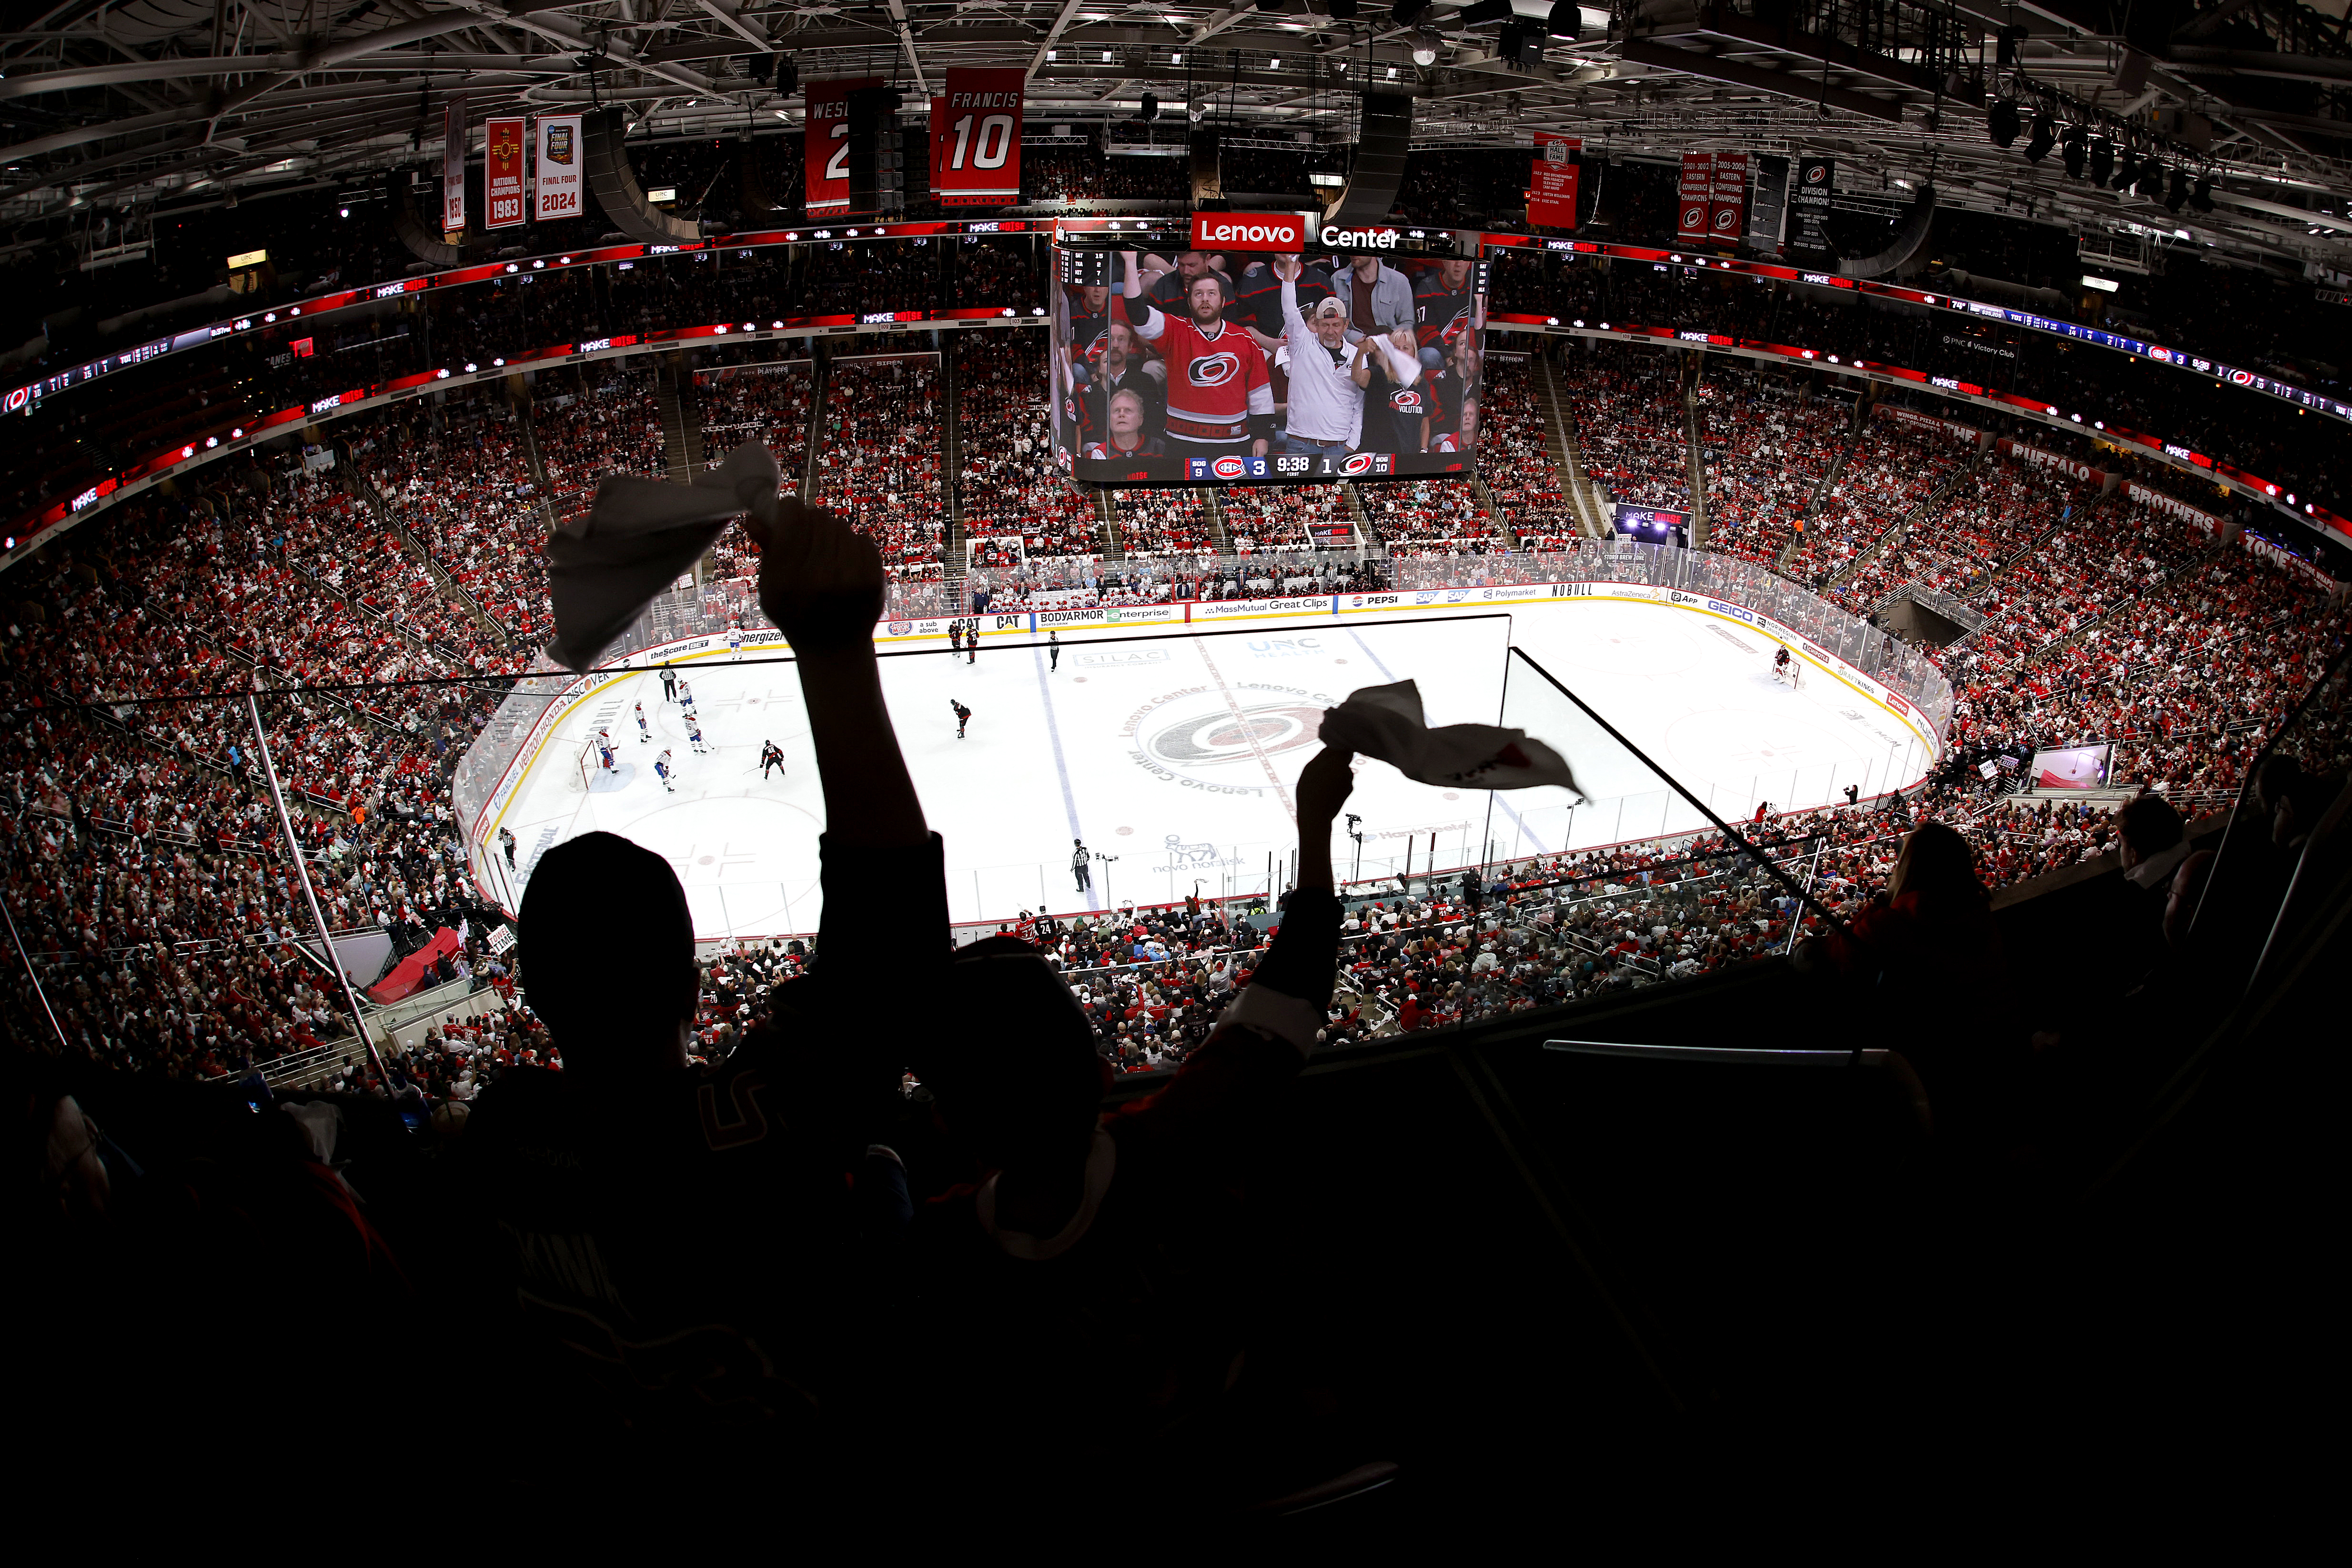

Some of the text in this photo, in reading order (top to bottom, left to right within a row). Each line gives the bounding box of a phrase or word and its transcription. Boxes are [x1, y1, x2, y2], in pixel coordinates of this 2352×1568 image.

[951, 92, 1018, 108] FRANCIS
[550, 141, 568, 150] FOUR
[951, 114, 1014, 170] 10
[1717, 161, 1745, 170] 2005-2006
[493, 176, 518, 187] NATIONAL
[542, 174, 577, 186] FINAL FOUR
[1720, 172, 1740, 181] EASTERN
[491, 185, 520, 197] CHAMPIONS
[1716, 183, 1742, 192] CONFERENCE
[1802, 187, 1827, 196] DIVISION
[542, 191, 576, 211] 2024
[1715, 193, 1741, 204] CHAMPIONS
[449, 197, 461, 219] 1950
[493, 199, 518, 219] 1983
[969, 221, 1026, 233] MAKE NOISE
[1201, 220, 1401, 249] Lenovo Center
[1548, 241, 1598, 252] MAKE NOISE
[377, 278, 428, 299] MAKE NOISE
[863, 310, 923, 324] MAKE NOISE
[1416, 306, 1425, 323] 37
[2010, 313, 2022, 322] TOI
[1951, 338, 2014, 358] PNC Victory Club
[2177, 354, 2184, 365] 3
[2192, 359, 2210, 370] 9:38
[83, 370, 92, 379] 15
[2218, 366, 2223, 377] 1
[33, 388, 41, 398] 10
[1943, 422, 1976, 444] THE
[1253, 460, 1266, 476] 3
[1277, 457, 1309, 472] 9:38
[1322, 459, 1332, 473] 1
[1376, 463, 1387, 472] 10
[2012, 443, 2090, 482] BUFFALO
[1195, 468, 1203, 477] 9
[2129, 484, 2214, 533] BROTHERS
[1625, 512, 1682, 524] MAKE NOISE
[2245, 534, 2290, 570] ZONE
[1448, 591, 1466, 602] SAP
[1496, 589, 1536, 597] Polymarket
[1552, 584, 1592, 597] NOBULL
[1612, 590, 1651, 599] AstraZeneca
[1270, 598, 1327, 609] Great Clips
[1368, 596, 1398, 604] PEPSI
[1417, 593, 1435, 603] SAP
[1108, 610, 1169, 619] enterprise
[1216, 603, 1266, 613] MassMutual
[1708, 600, 1753, 622] GEICO
[997, 615, 1020, 629] CAT
[1040, 610, 1104, 623] BODYARMOR
[1767, 621, 1797, 641] NORWEGIAN
[1247, 638, 1321, 652] UNC
[1716, 630, 1756, 654] CHIPOTLE
[651, 640, 709, 660] theScore BET
[1254, 647, 1325, 659] HEALTH
[1807, 645, 1829, 663] CHIPOTLE
[1083, 652, 1160, 663] SILAC
[567, 671, 609, 704] DISCOVER
[1838, 668, 1874, 694] DRAFTKINGS
[1119, 685, 1208, 737] Lenovo Center
[1888, 696, 1907, 714] Lenovo
[540, 700, 567, 734] HONDA
[1858, 720, 1902, 747] BETMGM
[519, 732, 542, 770] verizon
[1980, 762, 1993, 773] CANES
[2001, 759, 2015, 767] LOUD
[1128, 750, 1263, 797] Lenovo Center
[500, 768, 519, 801] FANDUEL
[476, 820, 488, 842] Lenovo
[1379, 823, 1472, 839] Harris Teeter
[1152, 856, 1246, 873] novo nordisk
[489, 926, 509, 943] TOWEL
[1024, 929, 1033, 938] 37
[1040, 925, 1051, 934] 24
[493, 932, 514, 952] TIME
[1193, 1026, 1205, 1036] 37
